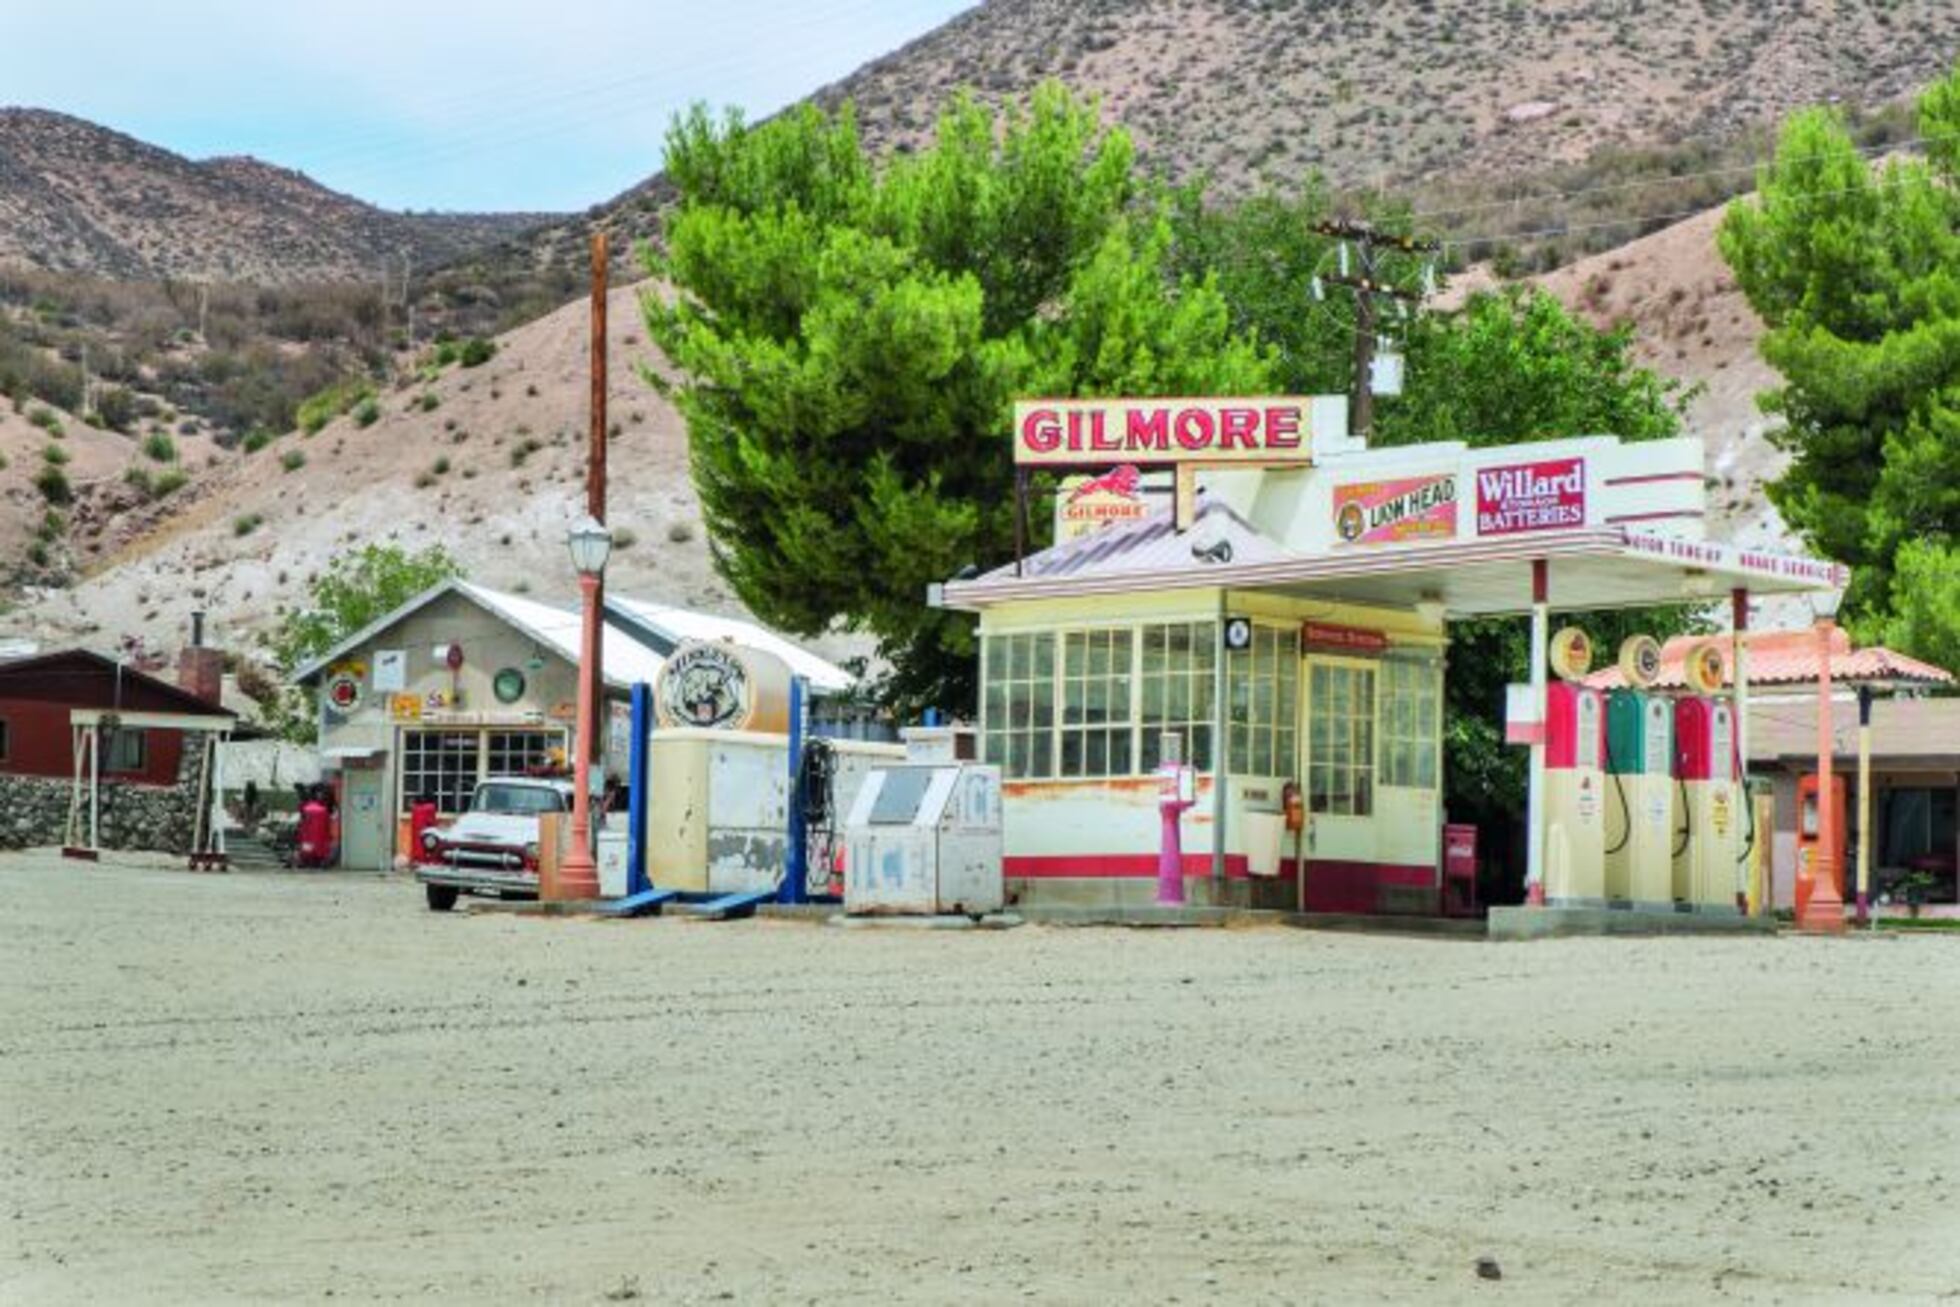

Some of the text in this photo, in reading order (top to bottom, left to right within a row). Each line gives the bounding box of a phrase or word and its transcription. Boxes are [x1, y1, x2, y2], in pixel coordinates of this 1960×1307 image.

[1022, 406, 1303, 453] GILMORE
[1409, 479, 1455, 511] HEAD
[1478, 464, 1583, 502] Willard
[1479, 504, 1582, 531] BATTERIES
